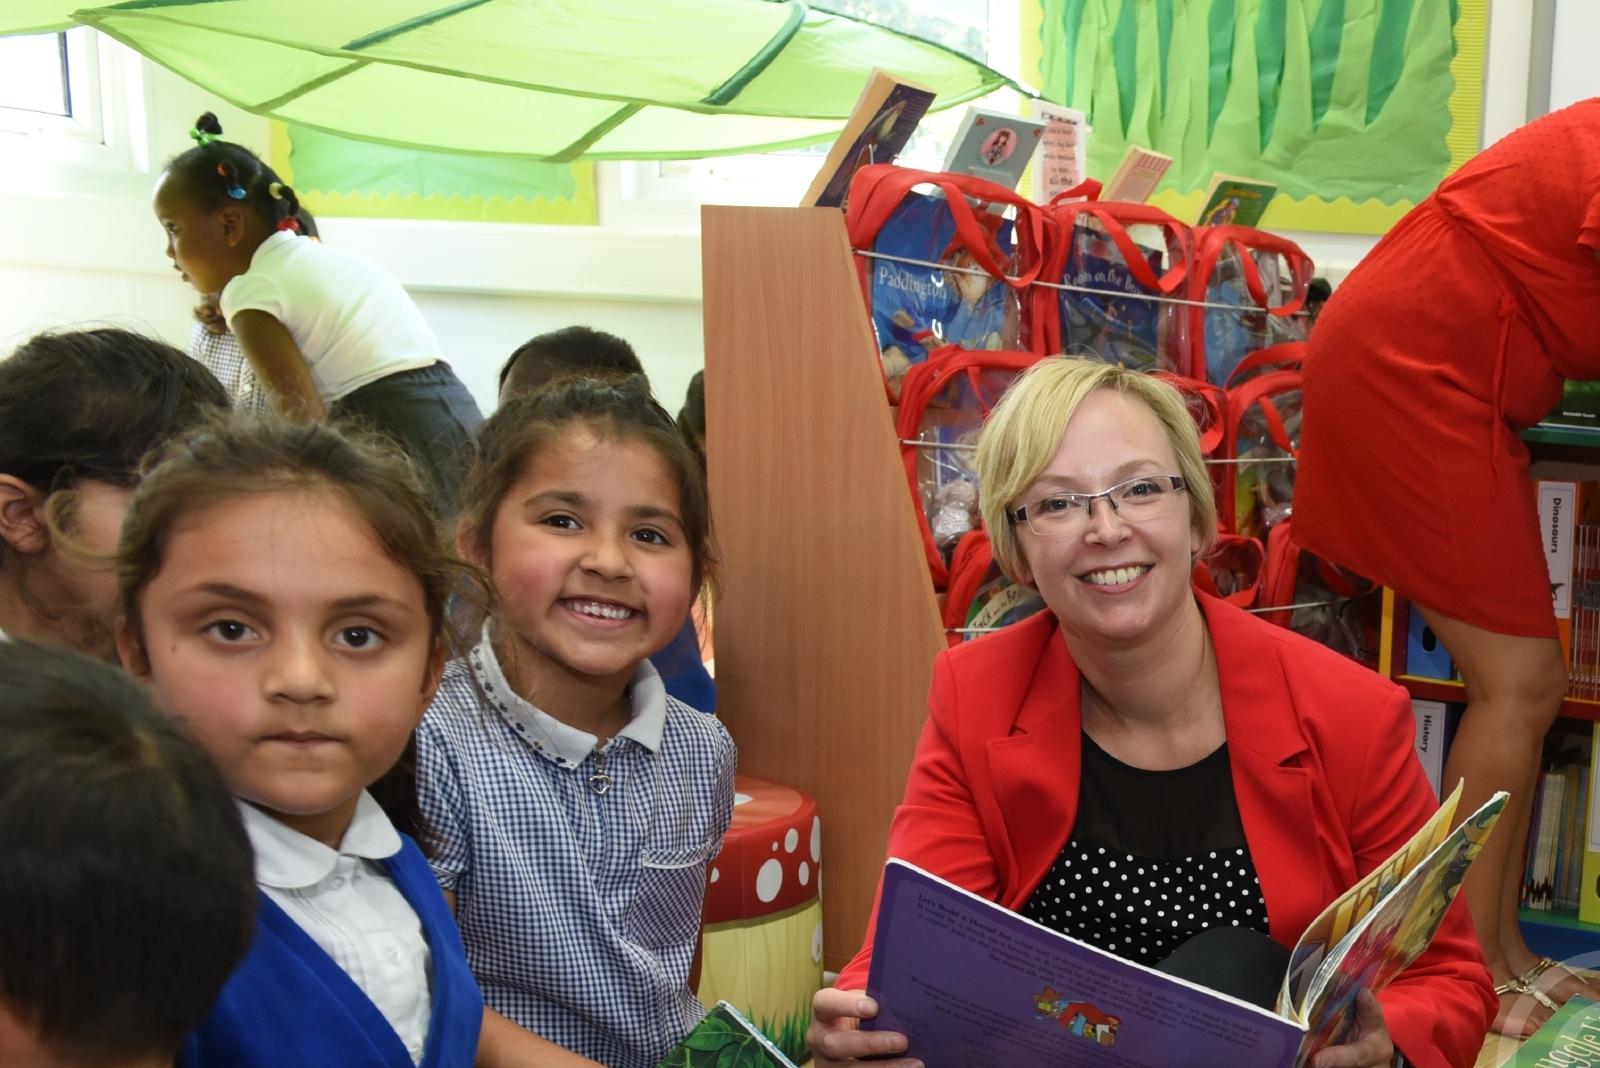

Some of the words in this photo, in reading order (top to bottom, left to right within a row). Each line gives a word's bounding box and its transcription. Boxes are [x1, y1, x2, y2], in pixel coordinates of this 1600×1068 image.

[879, 266, 947, 300] Paddington
[1551, 497, 1562, 554] Dinosaurs
[1420, 714, 1432, 753] History
